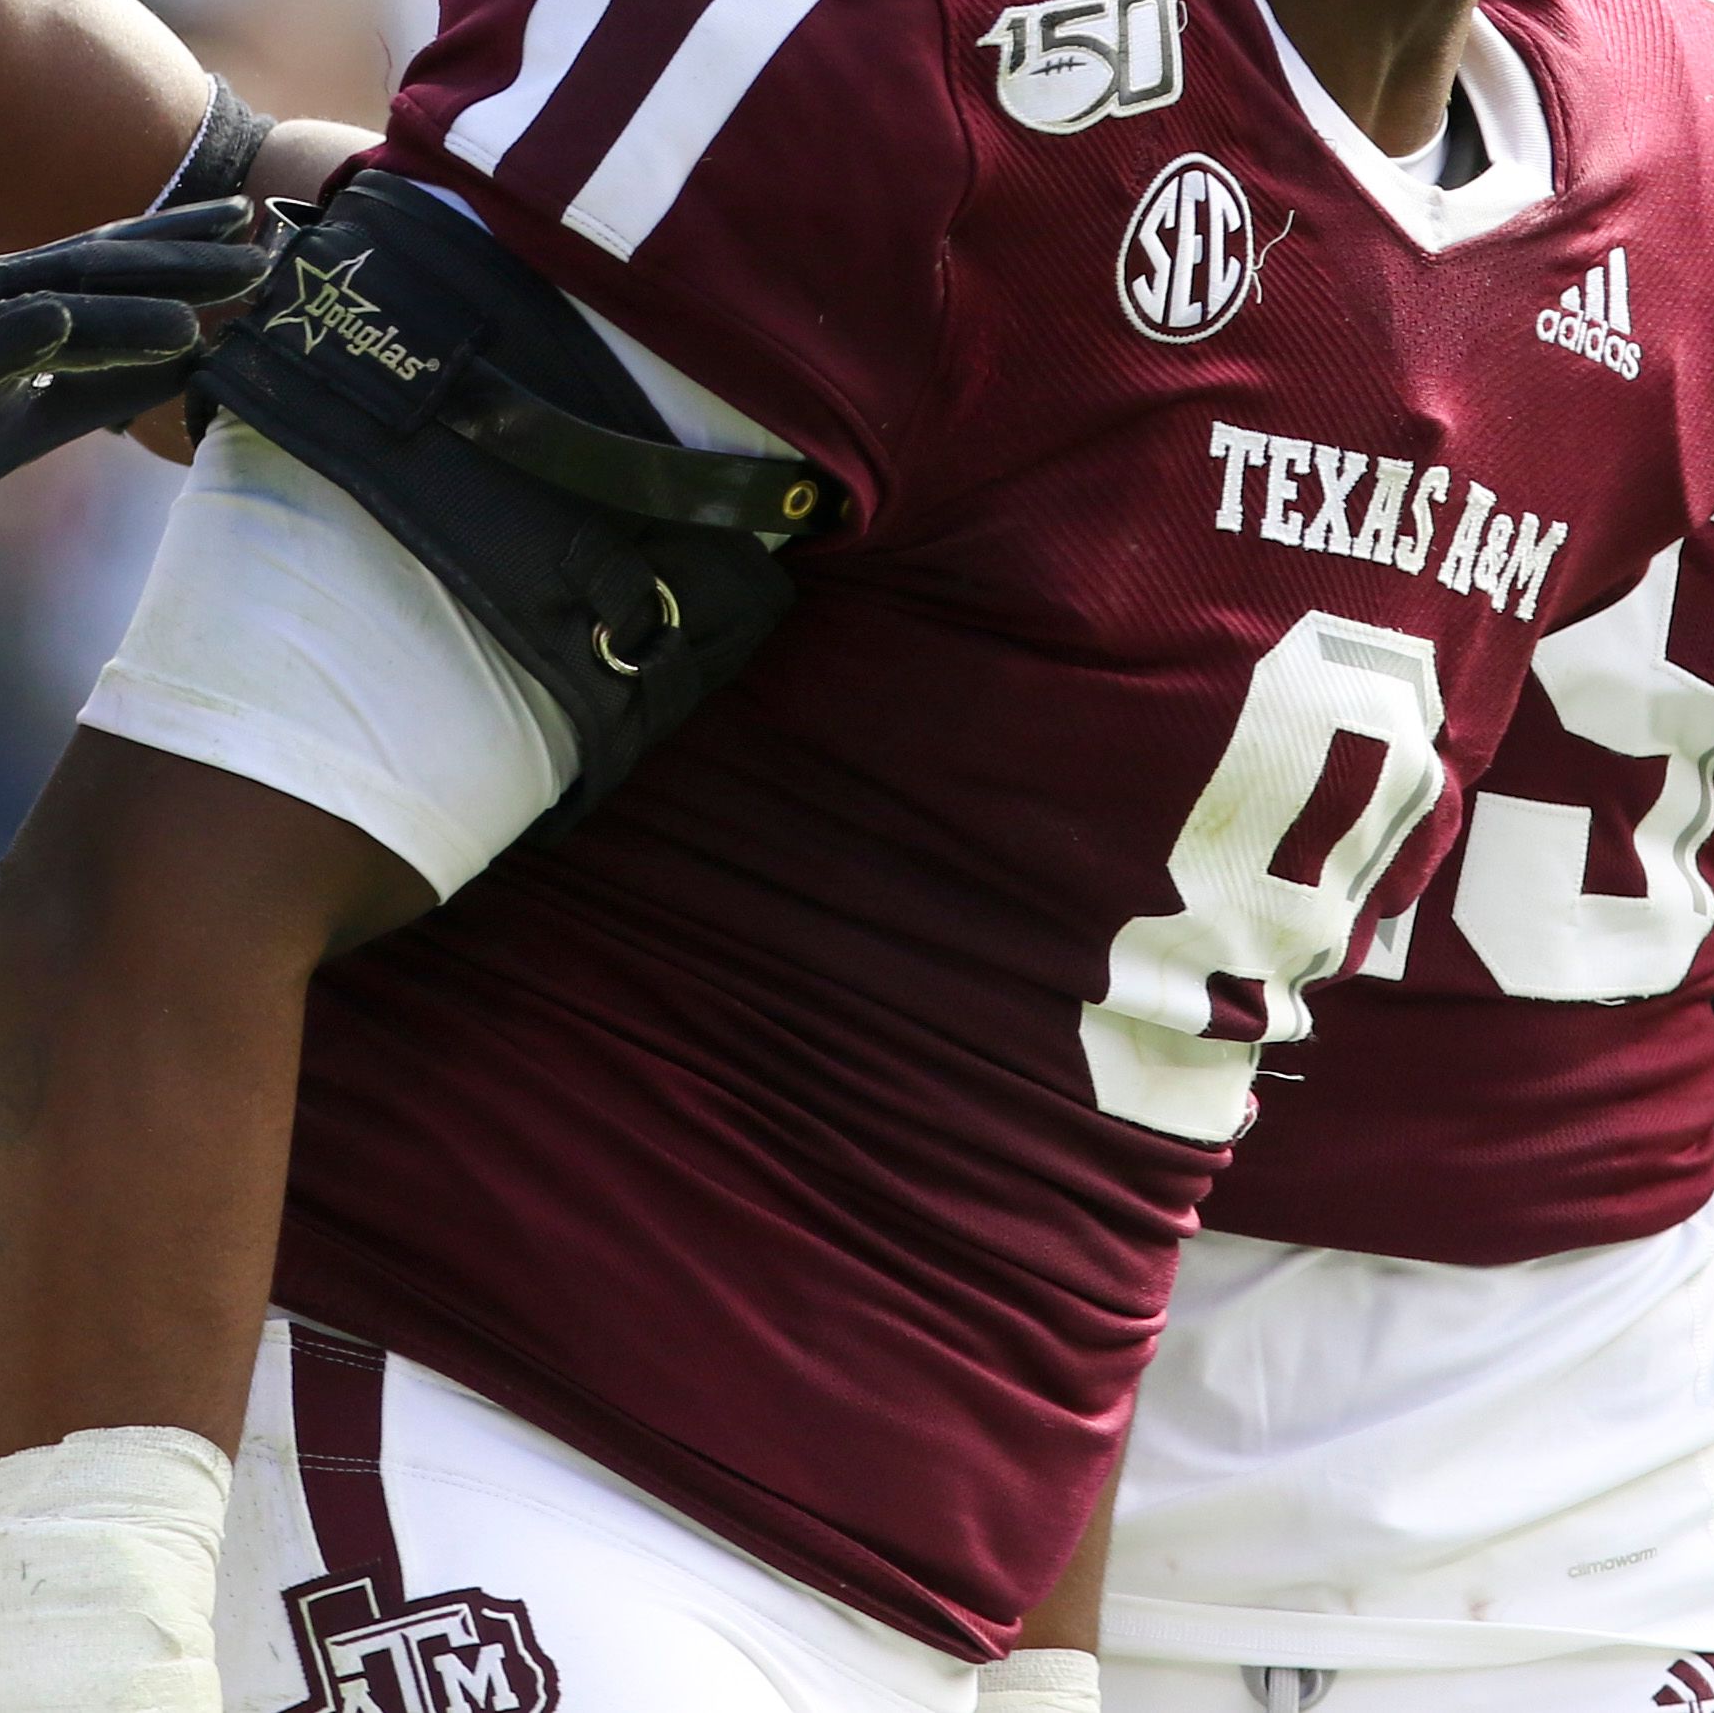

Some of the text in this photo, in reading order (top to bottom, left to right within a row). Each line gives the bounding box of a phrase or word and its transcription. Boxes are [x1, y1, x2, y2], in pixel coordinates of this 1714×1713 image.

[1131, 170, 1245, 329] SEC
[303, 282, 425, 381] Douglas
[1535, 303, 1641, 381] adidas
[1209, 418, 1569, 623] TEXAS A&M
[1078, 609, 1447, 1146] 8
[1567, 1547, 1658, 1578] climawarm
